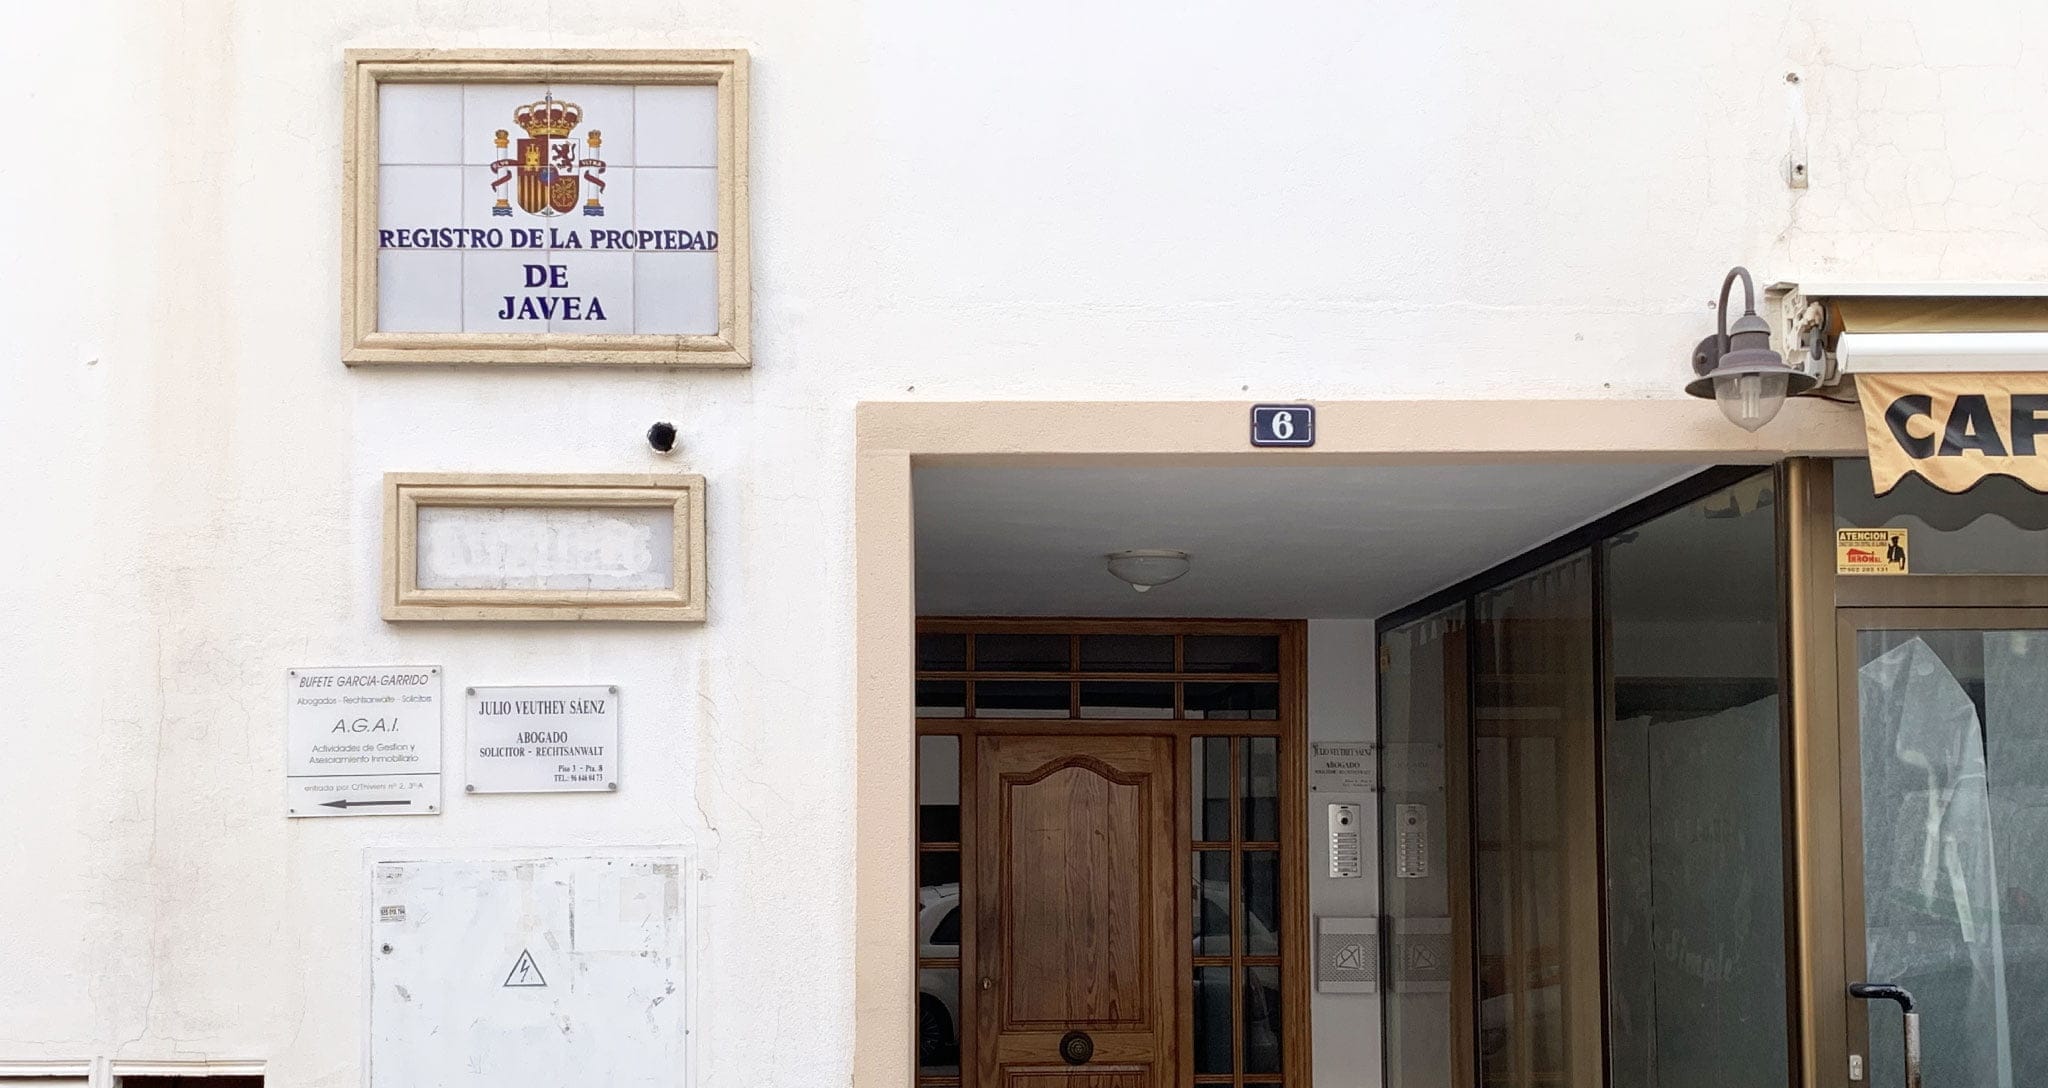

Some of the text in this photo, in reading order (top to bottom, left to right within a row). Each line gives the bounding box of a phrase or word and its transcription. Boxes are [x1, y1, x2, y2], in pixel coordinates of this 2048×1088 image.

[379, 228, 719, 250] REGISTRO DE LA PROPIEDAD
[523, 264, 569, 288] DE
[498, 296, 607, 320] JAVEA
[1272, 411, 1294, 439] 6
[1839, 532, 1887, 541] ATENCION
[299, 674, 429, 688] BUFETE GARCIA-GARRIDO
[297, 696, 337, 707] Abogados
[478, 697, 605, 716] JULIO VEUTHEY SÁENZ
[331, 718, 399, 733] A.G.A.I.
[516, 731, 568, 744] ABOGADO
[312, 744, 361, 753] Actividades
[362, 743, 374, 752] de
[410, 744, 416, 752] y
[479, 747, 526, 758] SOLICITOR
[535, 746, 604, 757] RECHTSANWALT
